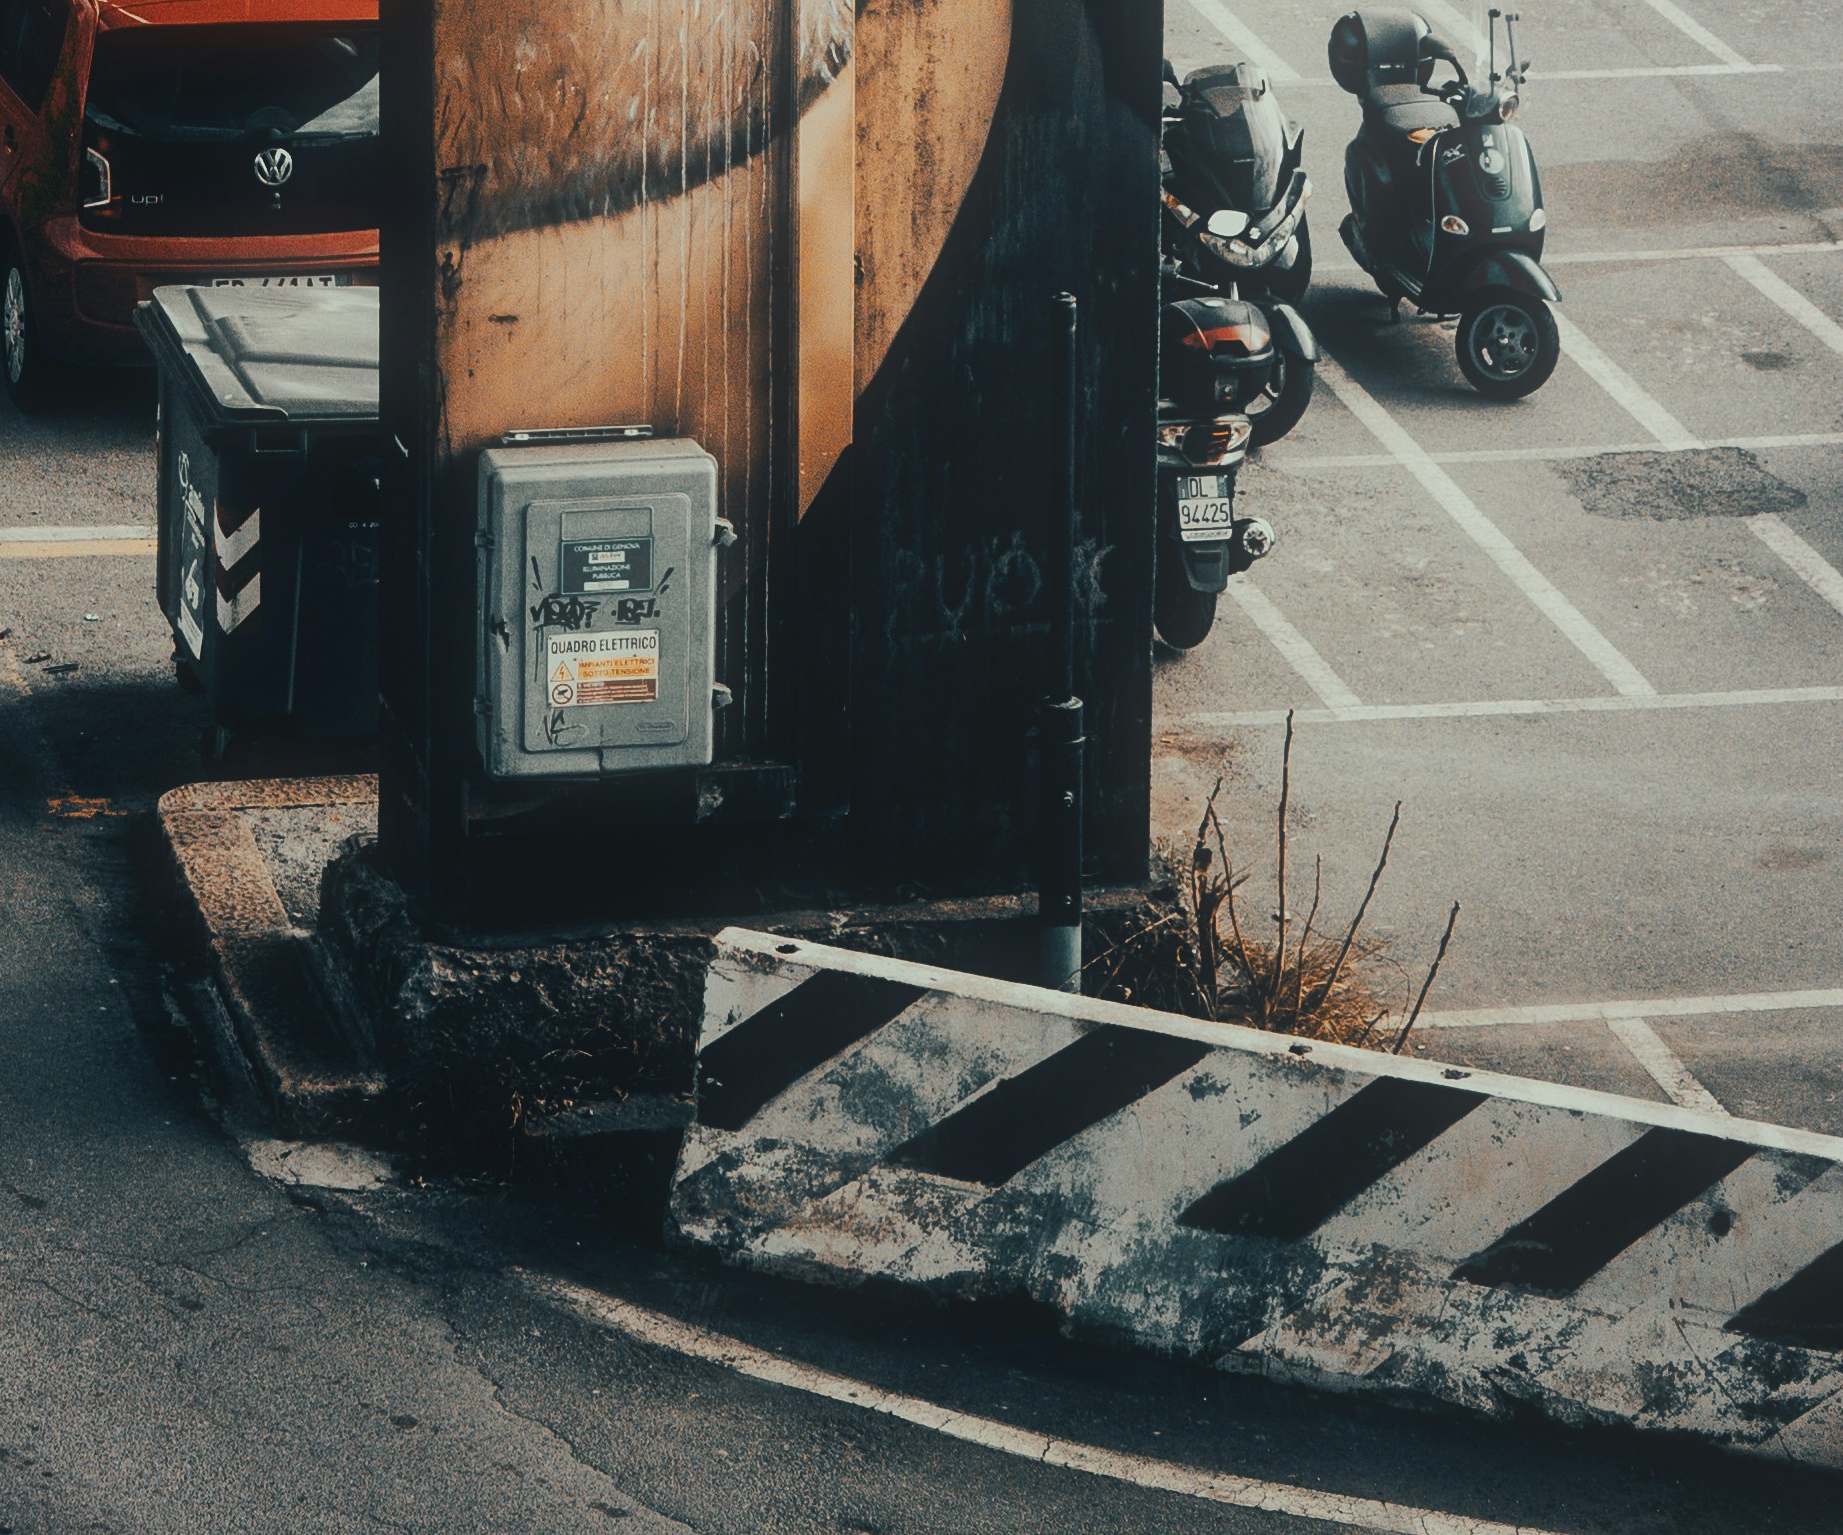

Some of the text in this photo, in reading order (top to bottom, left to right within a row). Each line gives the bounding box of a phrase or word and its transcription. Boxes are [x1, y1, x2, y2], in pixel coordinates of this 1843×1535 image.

[1188, 478, 1209, 498] DL
[1181, 502, 1230, 525] 94425
[551, 636, 657, 654] QUADRO ELETTRICO
[578, 658, 655, 668] IMPIANTI ELETTRICI
[611, 667, 650, 676] TENSIONE
